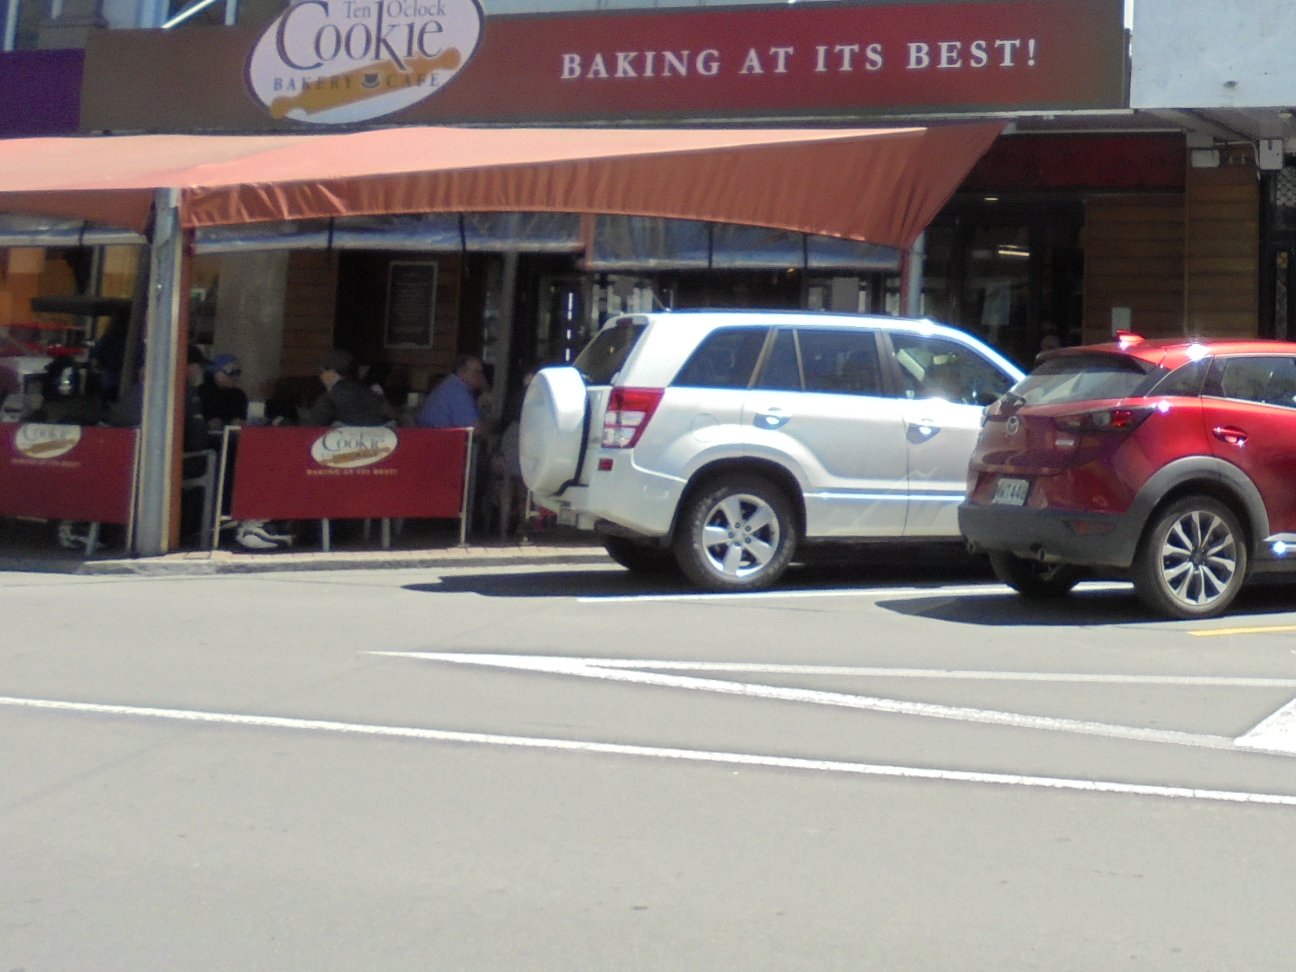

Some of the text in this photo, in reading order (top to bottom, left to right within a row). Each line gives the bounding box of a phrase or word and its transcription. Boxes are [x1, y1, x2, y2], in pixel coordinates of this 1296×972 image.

[343, 0, 372, 19] Ten
[275, 0, 444, 71] Cookie
[560, 37, 1036, 80] BAKING AT ITS BEST!
[273, 73, 440, 92] BAKERY CAFE
